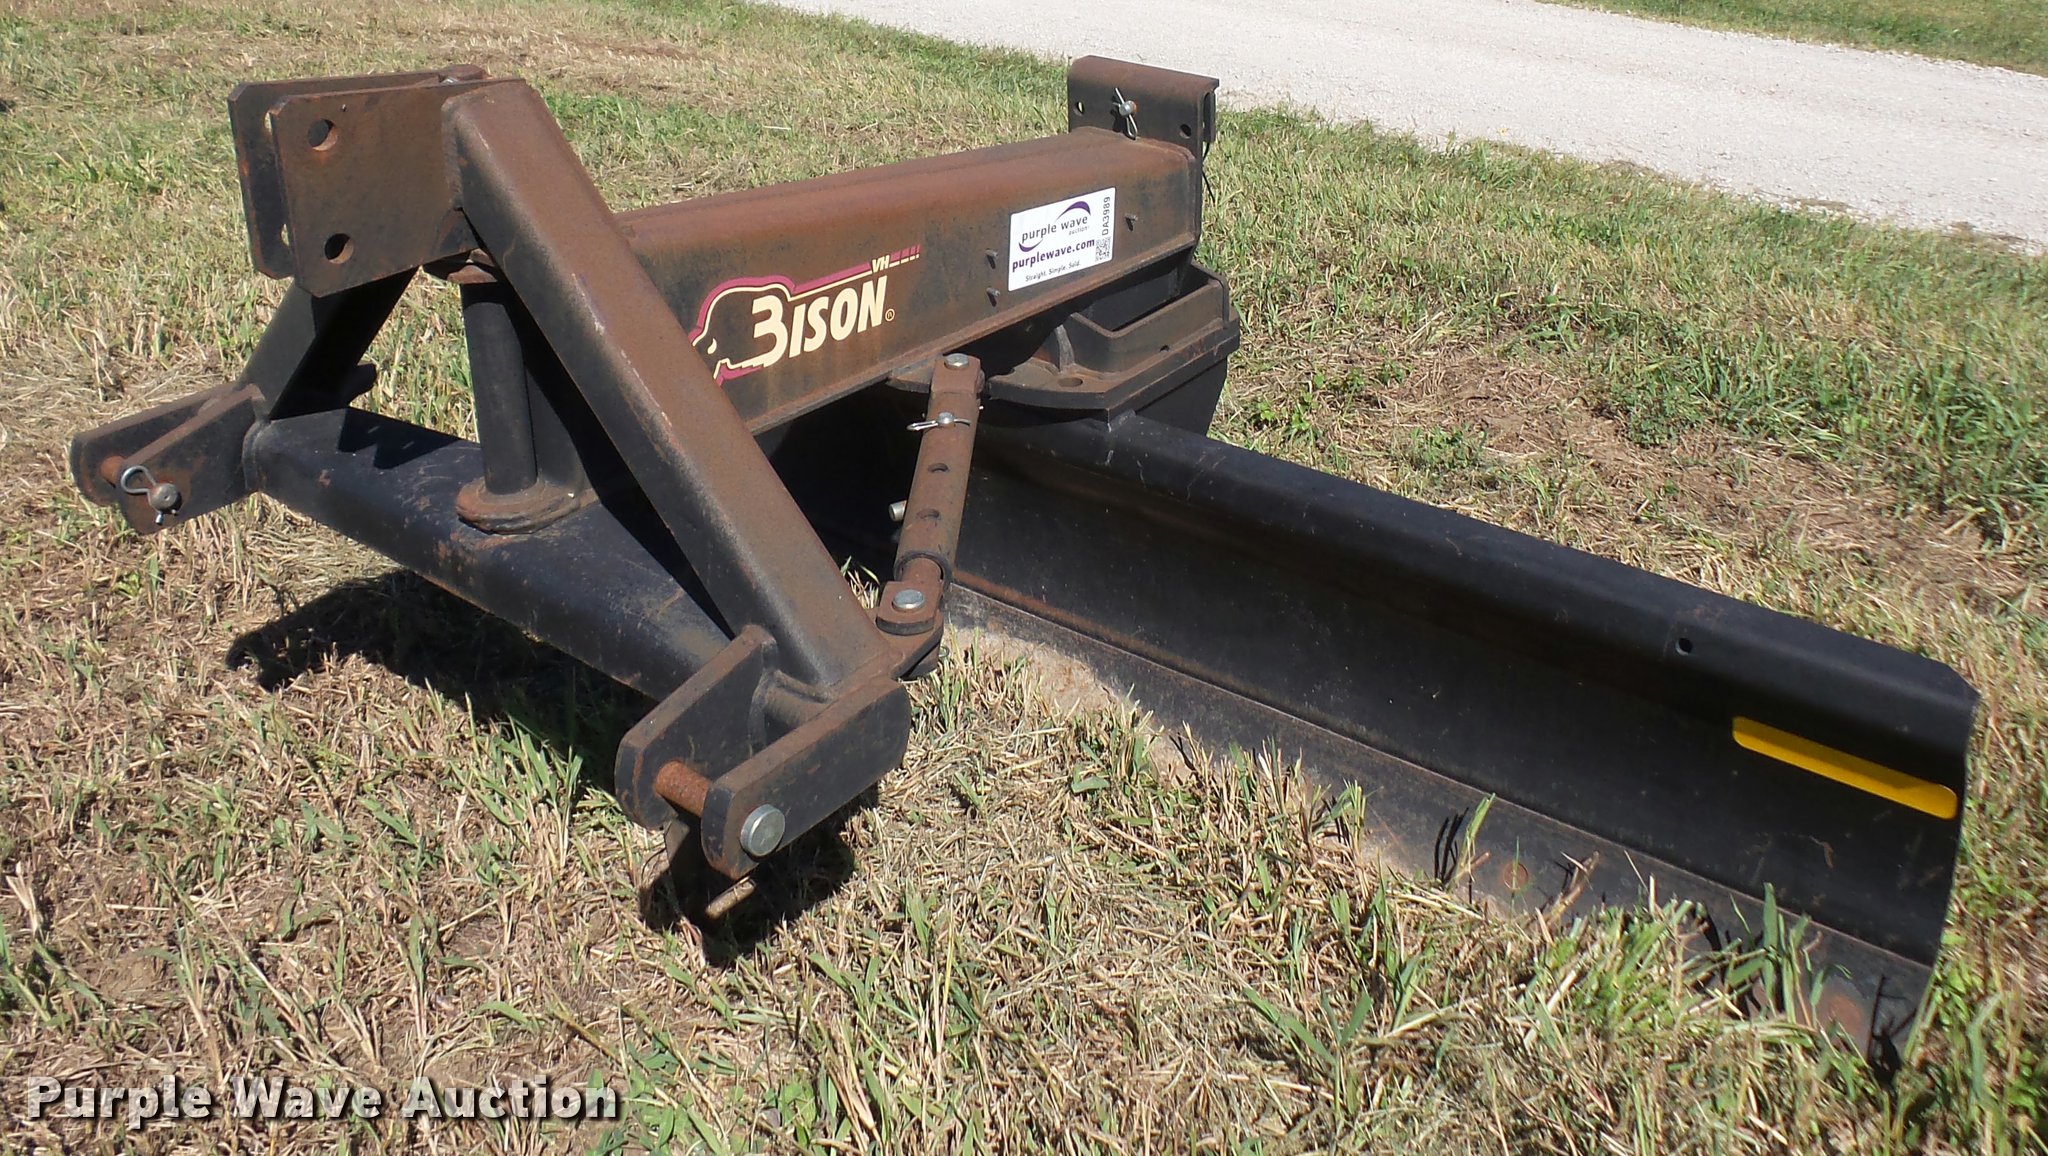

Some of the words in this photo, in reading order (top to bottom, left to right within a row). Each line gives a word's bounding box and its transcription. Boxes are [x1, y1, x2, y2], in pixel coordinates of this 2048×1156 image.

[1021, 223, 1057, 244] purple
[1060, 216, 1088, 231] wave
[1101, 196, 1111, 236] DA3989
[871, 255, 890, 273] VH
[1012, 239, 1095, 273] purplewave.com
